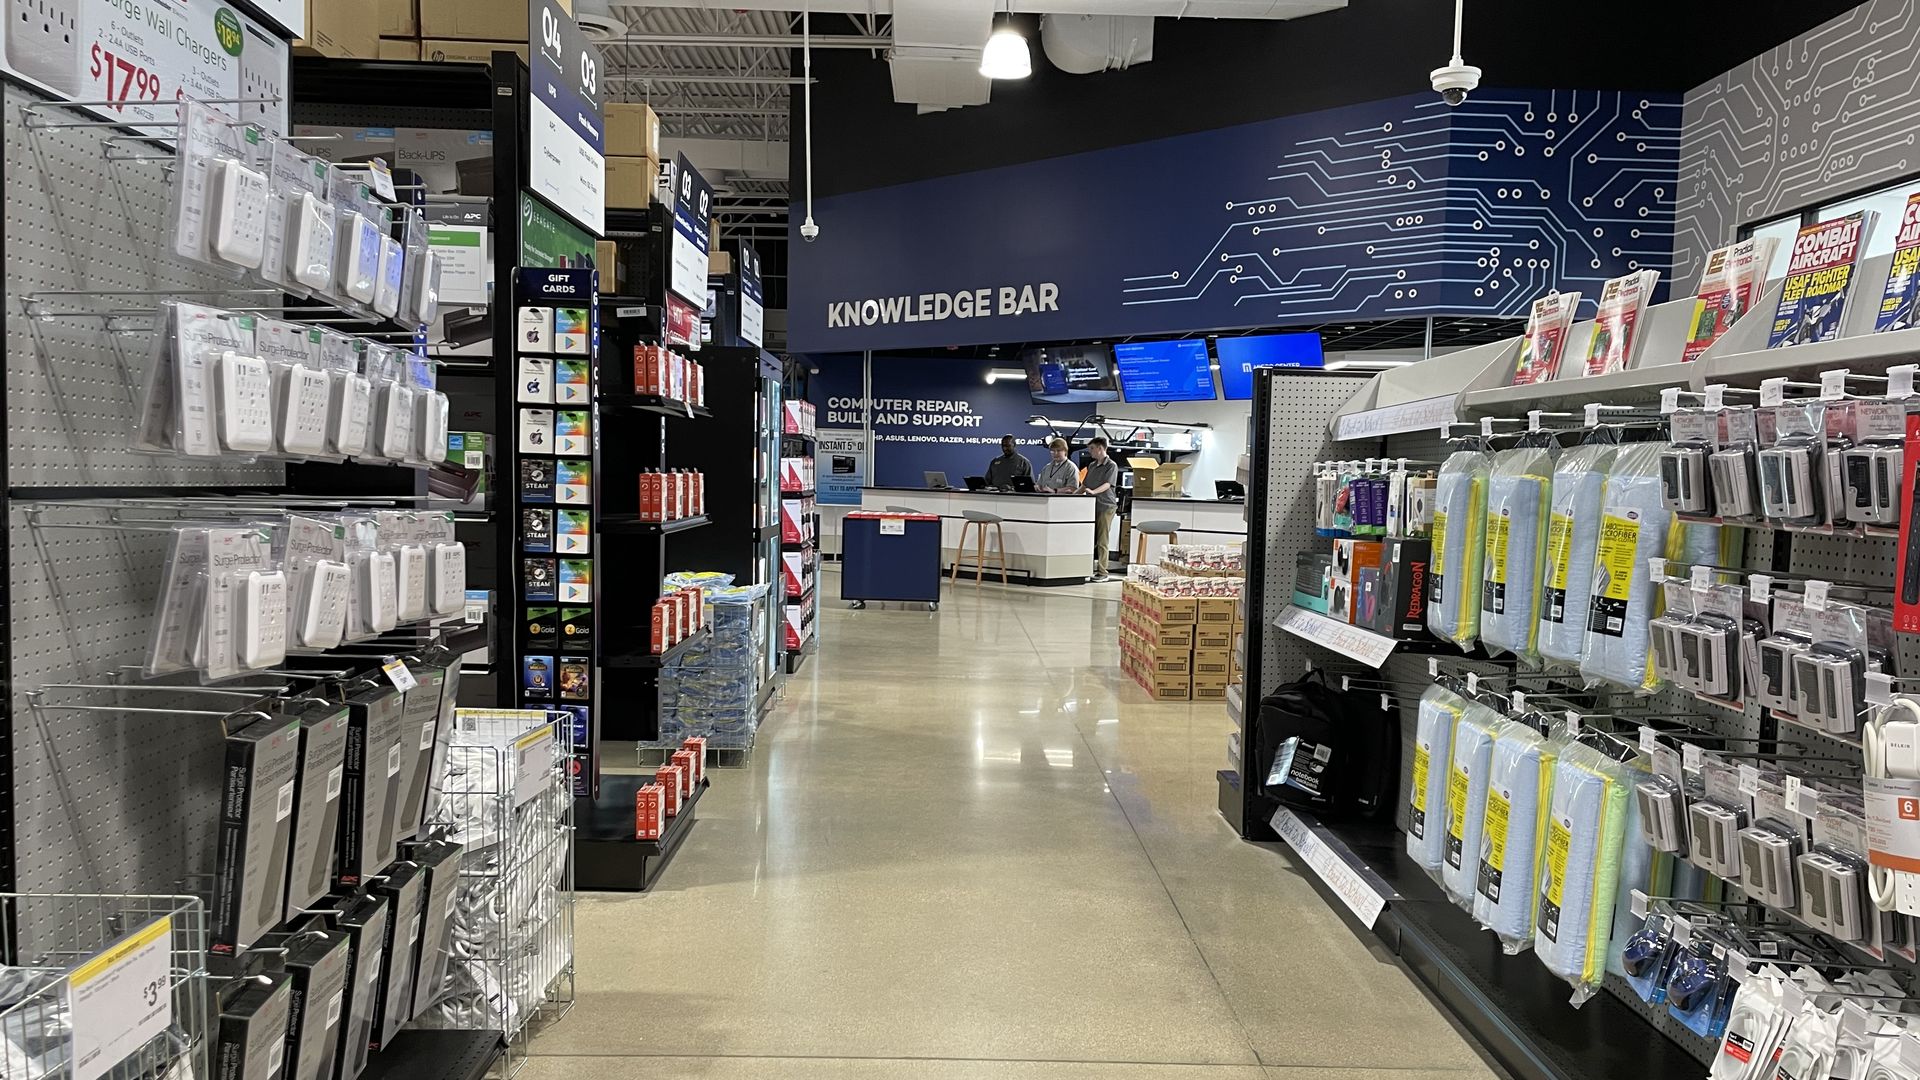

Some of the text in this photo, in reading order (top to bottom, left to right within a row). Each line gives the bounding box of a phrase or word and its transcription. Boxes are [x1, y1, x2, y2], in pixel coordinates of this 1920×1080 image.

[104, 0, 141, 20] urge
[145, 7, 171, 40] Wall
[176, 27, 228, 72] Chargers
[121, 27, 145, 46] Outlets
[542, 6, 561, 58] 04
[124, 42, 138, 57] USB
[139, 50, 156, 67] Ports
[201, 71, 219, 88] Outlets
[581, 50, 596, 95] 03
[203, 86, 215, 98] USB
[548, 82, 557, 98] UPS
[398, 150, 446, 161] Back-UPS
[682, 170, 691, 201] 03
[700, 189, 708, 218] 02
[533, 214, 556, 234] SEAGATE
[1795, 220, 1862, 255] COMBAT
[1734, 242, 1754, 256] Practical
[1790, 241, 1856, 271] AIRCRAFT
[548, 274, 570, 282] GIFT
[1785, 265, 1851, 291] USAF FIGHTER
[542, 285, 575, 293] CARDS
[1782, 279, 1847, 302] FLEET ROADMAP
[828, 282, 1059, 328] KNOWLEDGE BAR
[260, 343, 309, 361] Surge Protector
[828, 397, 973, 414] COMUTER REPAIR,
[875, 413, 983, 427] AND SUPPORT
[819, 441, 846, 450] INSTANT
[907, 436, 938, 444] LENOVO,
[291, 540, 334, 555] Surge Protector
[179, 553, 200, 567] Surge
[214, 554, 262, 567] Surge Protector
[1406, 562, 1426, 618] REDRAGON
[1291, 770, 1320, 785] notebook
[235, 767, 247, 818] Surge Protector
[1904, 801, 1913, 813] 6
[212, 944, 233, 952] APC
